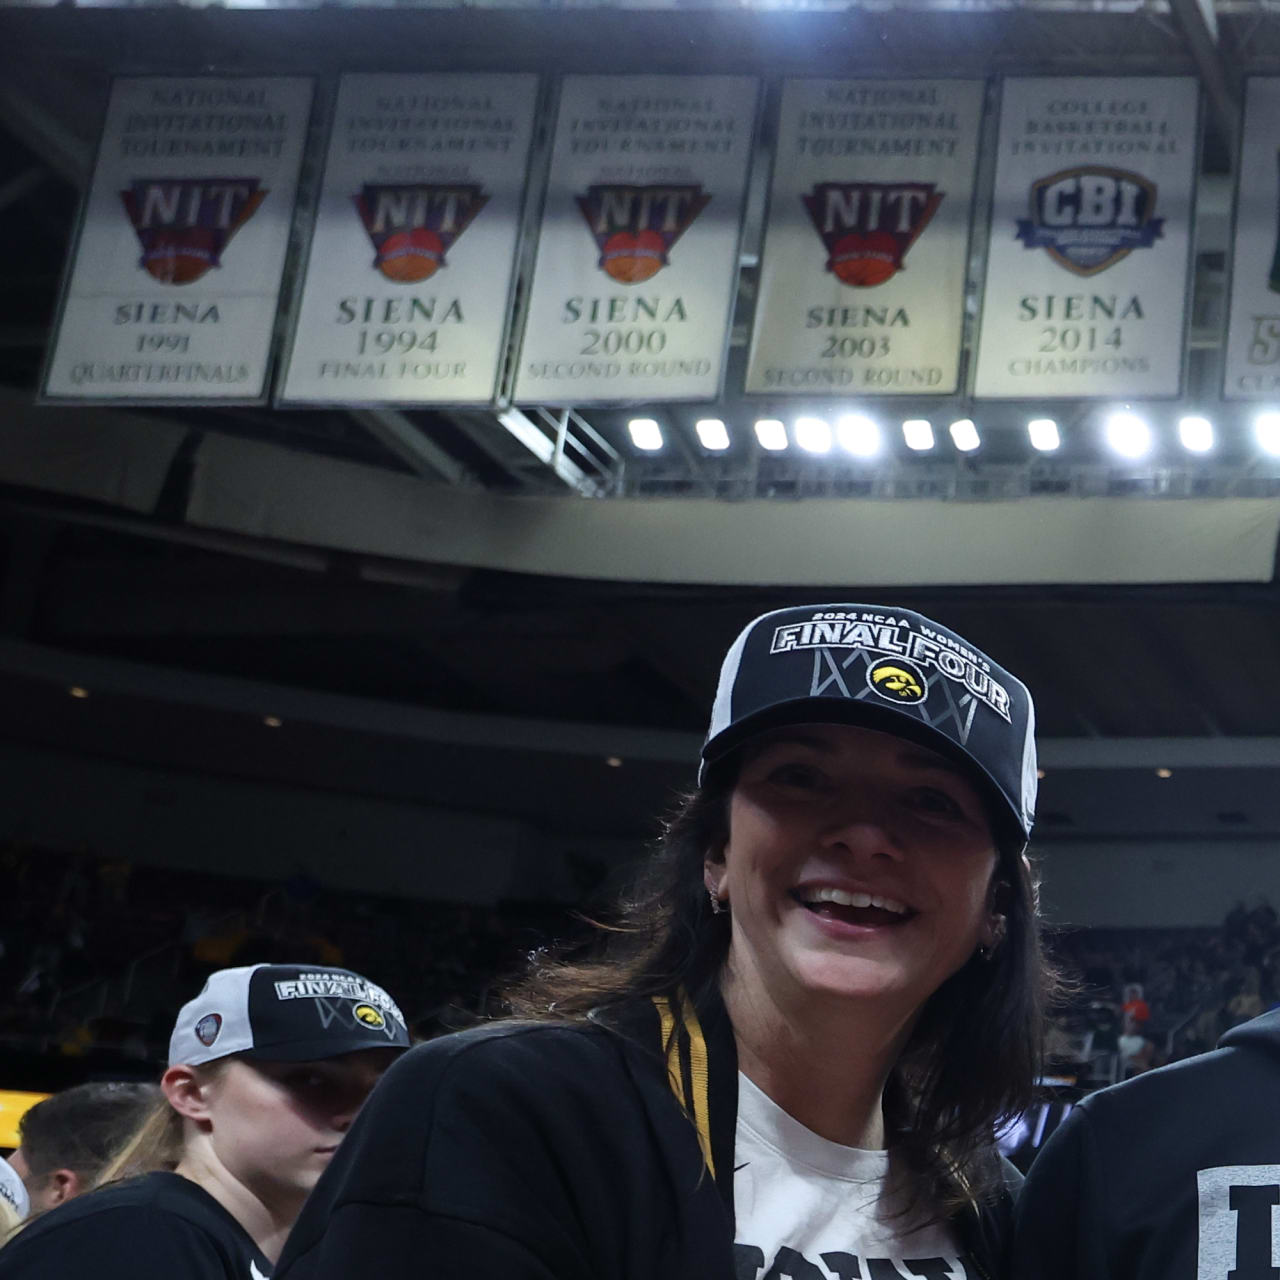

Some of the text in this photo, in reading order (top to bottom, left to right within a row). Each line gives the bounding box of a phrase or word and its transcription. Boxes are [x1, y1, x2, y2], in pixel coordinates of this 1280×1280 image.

[141, 185, 249, 230] NIT
[372, 190, 470, 232] NIT
[596, 190, 692, 233] NIT
[823, 190, 930, 234] NIT
[1042, 174, 1140, 228] CBI
[113, 302, 221, 325] SIENA
[335, 295, 466, 325] SIENA
[560, 296, 688, 325] SIENA
[805, 304, 910, 329] SIENA
[1018, 294, 1145, 322] SIENA
[355, 329, 441, 355] 1994
[579, 328, 667, 356] 2000
[819, 335, 891, 359] 2003
[1038, 326, 1123, 353] 2014
[317, 361, 468, 380] FINAL FOUR
[527, 360, 711, 379] SECOND ROUND
[762, 367, 943, 387] SECOND ROUND
[1007, 356, 1151, 377] CHAMPIONS
[811, 612, 991, 673] 2024 NCAA WOMEN'S
[769, 620, 1012, 724] FINAL FOUR
[274, 979, 368, 1001] FINAL
